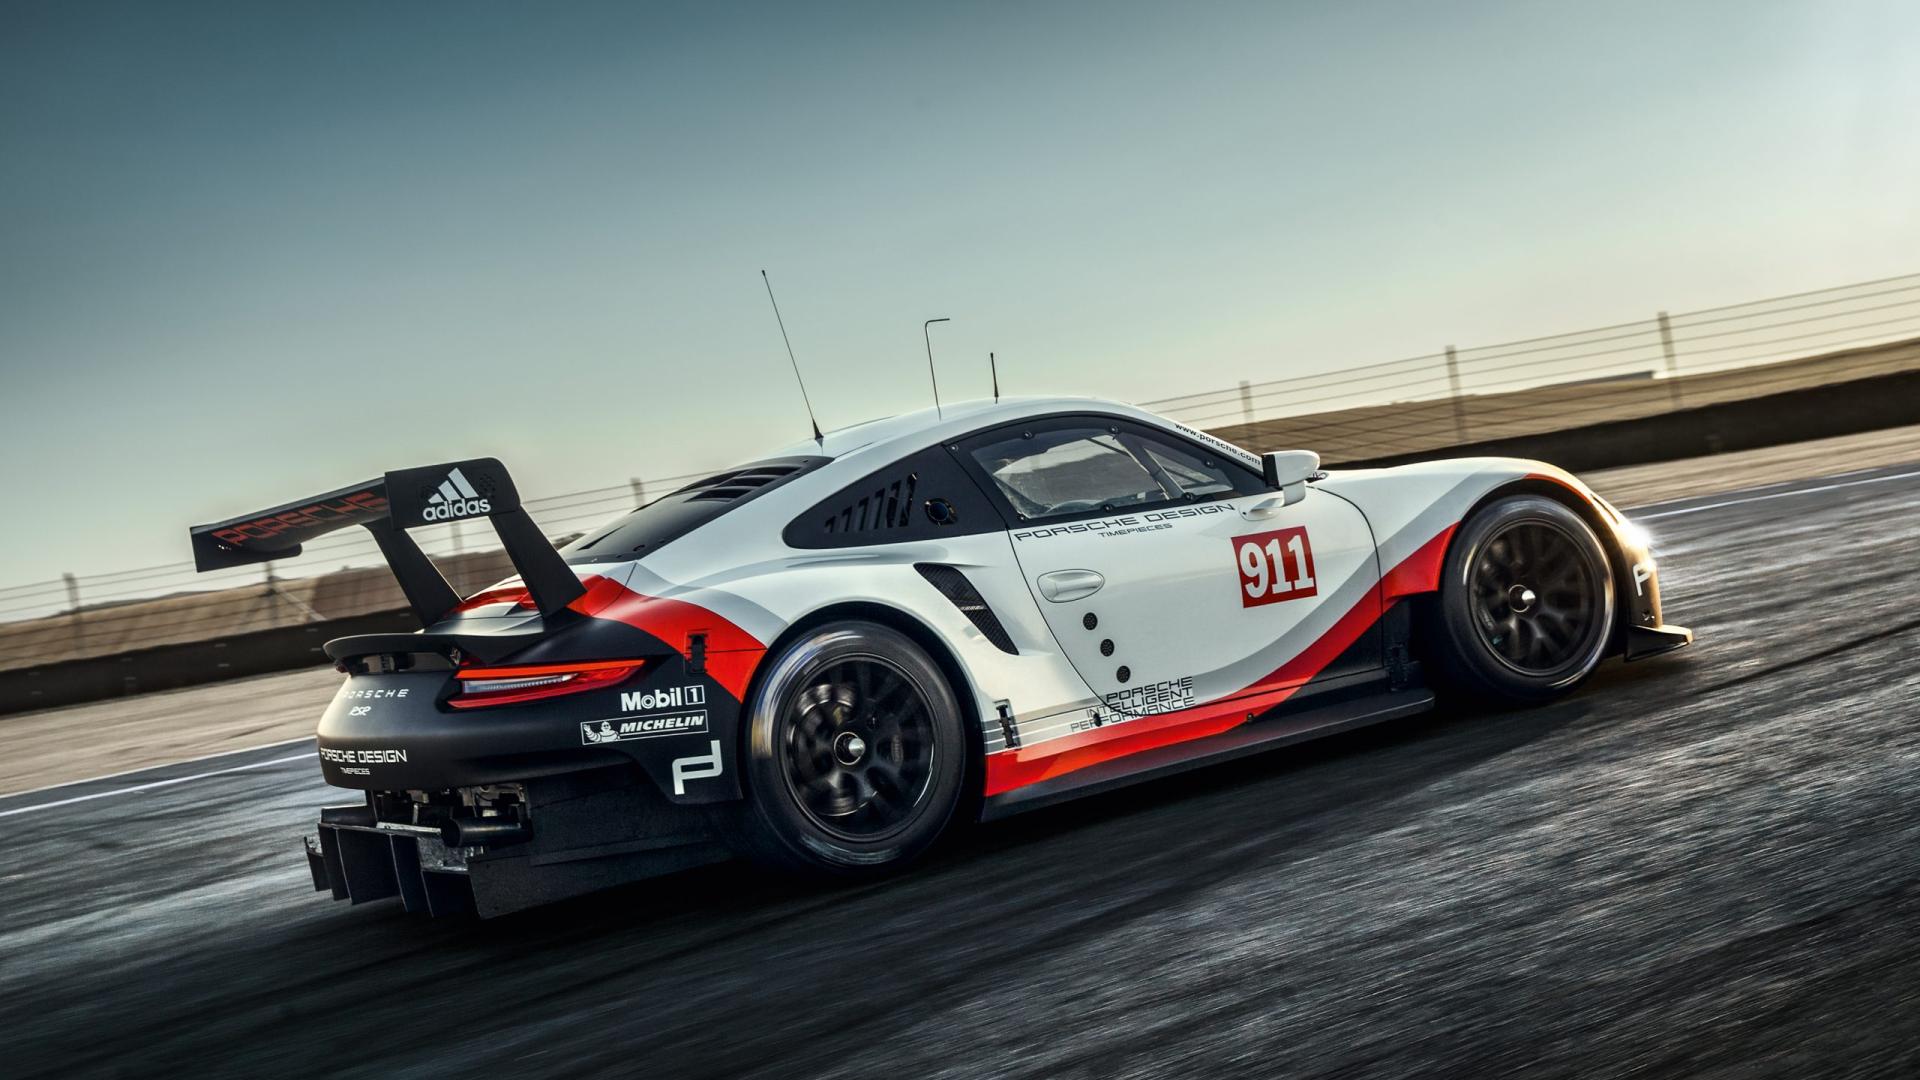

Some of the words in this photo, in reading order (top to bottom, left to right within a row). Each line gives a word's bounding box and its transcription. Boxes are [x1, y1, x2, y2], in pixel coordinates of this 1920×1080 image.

[1174, 423, 1261, 465] www.porsche.com
[211, 491, 390, 546] PORSCHE
[422, 498, 491, 521] adidas
[1013, 516, 1140, 542] PORSCHE
[1144, 502, 1236, 523] DESIGN
[1097, 522, 1173, 538] TIMEPIECES
[1239, 534, 1315, 599] 911
[343, 688, 410, 699] ORSCHE
[620, 687, 682, 712] Mobil
[1106, 676, 1193, 702] PORSCHE
[1086, 686, 1193, 718] INTELLIGENT
[620, 715, 704, 733] MICHELIN
[357, 749, 408, 763] DESIGN
